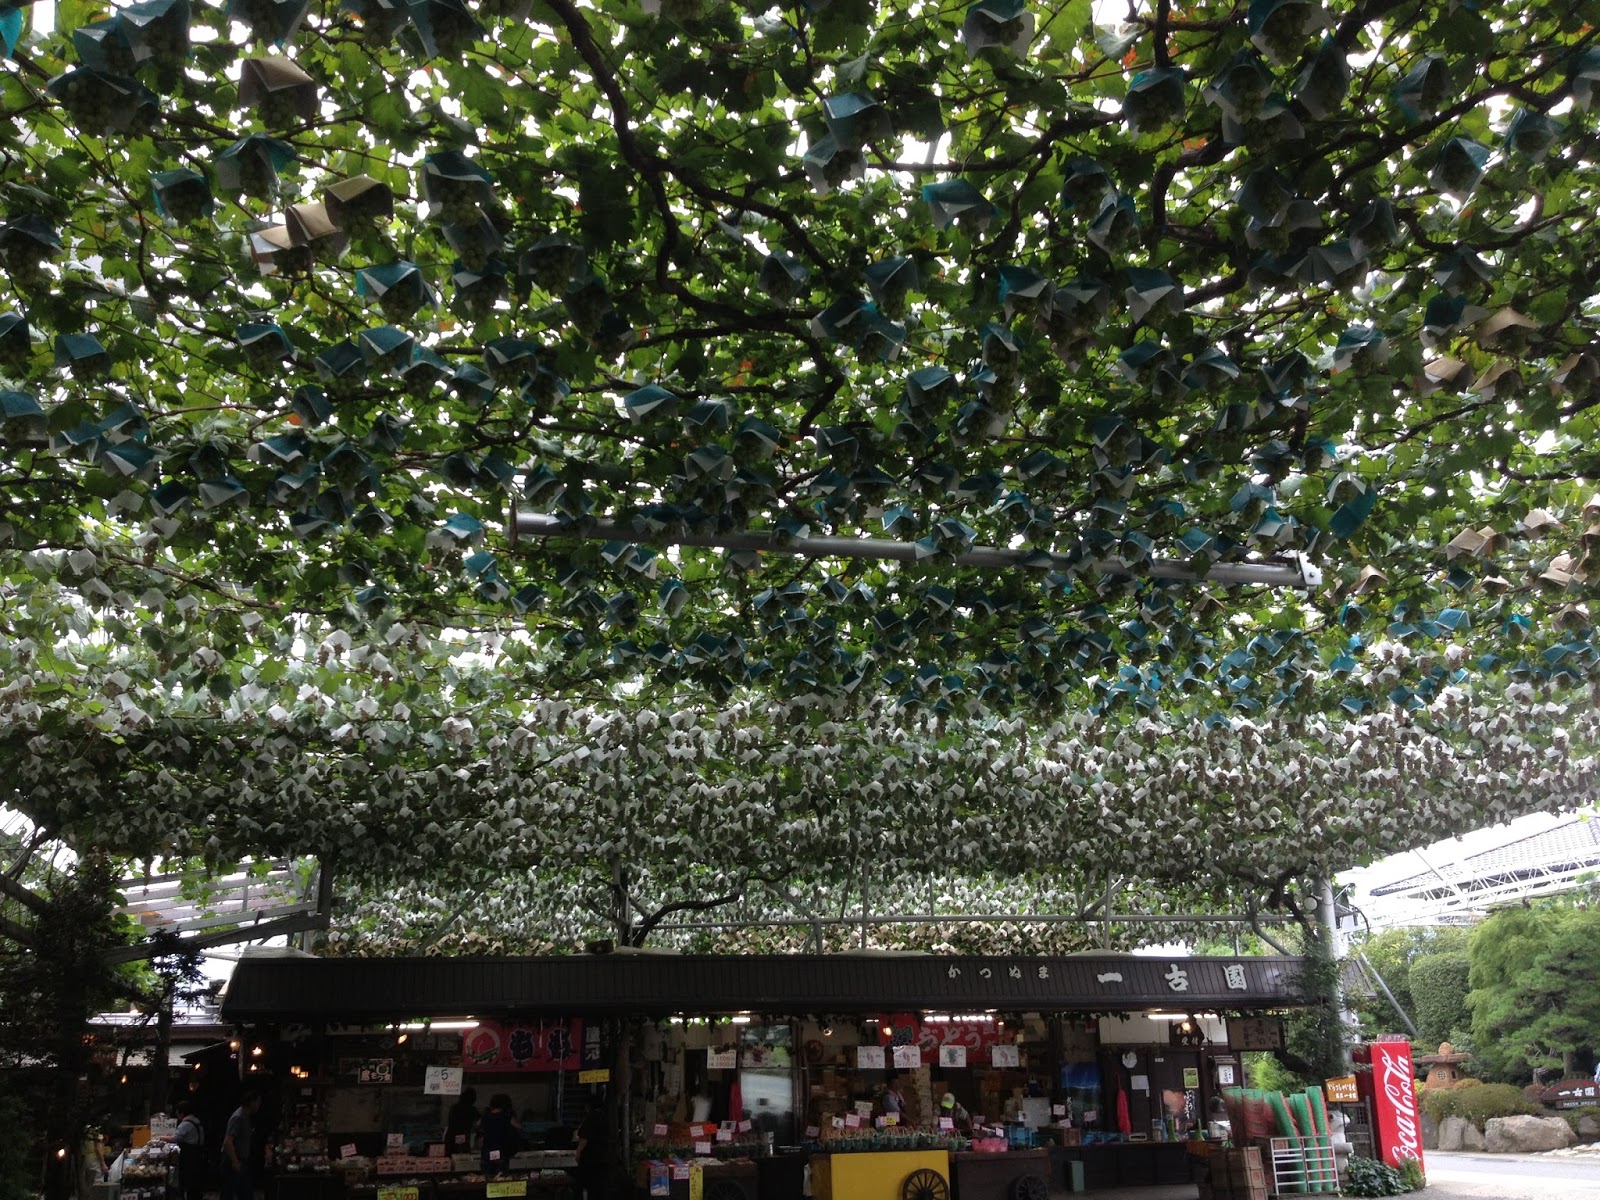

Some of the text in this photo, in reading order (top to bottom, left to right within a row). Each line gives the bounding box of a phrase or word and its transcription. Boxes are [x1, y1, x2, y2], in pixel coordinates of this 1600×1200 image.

[947, 963, 1248, 992] かつぬま 一古園
[1379, 1046, 1419, 1167] Coca-Cola
